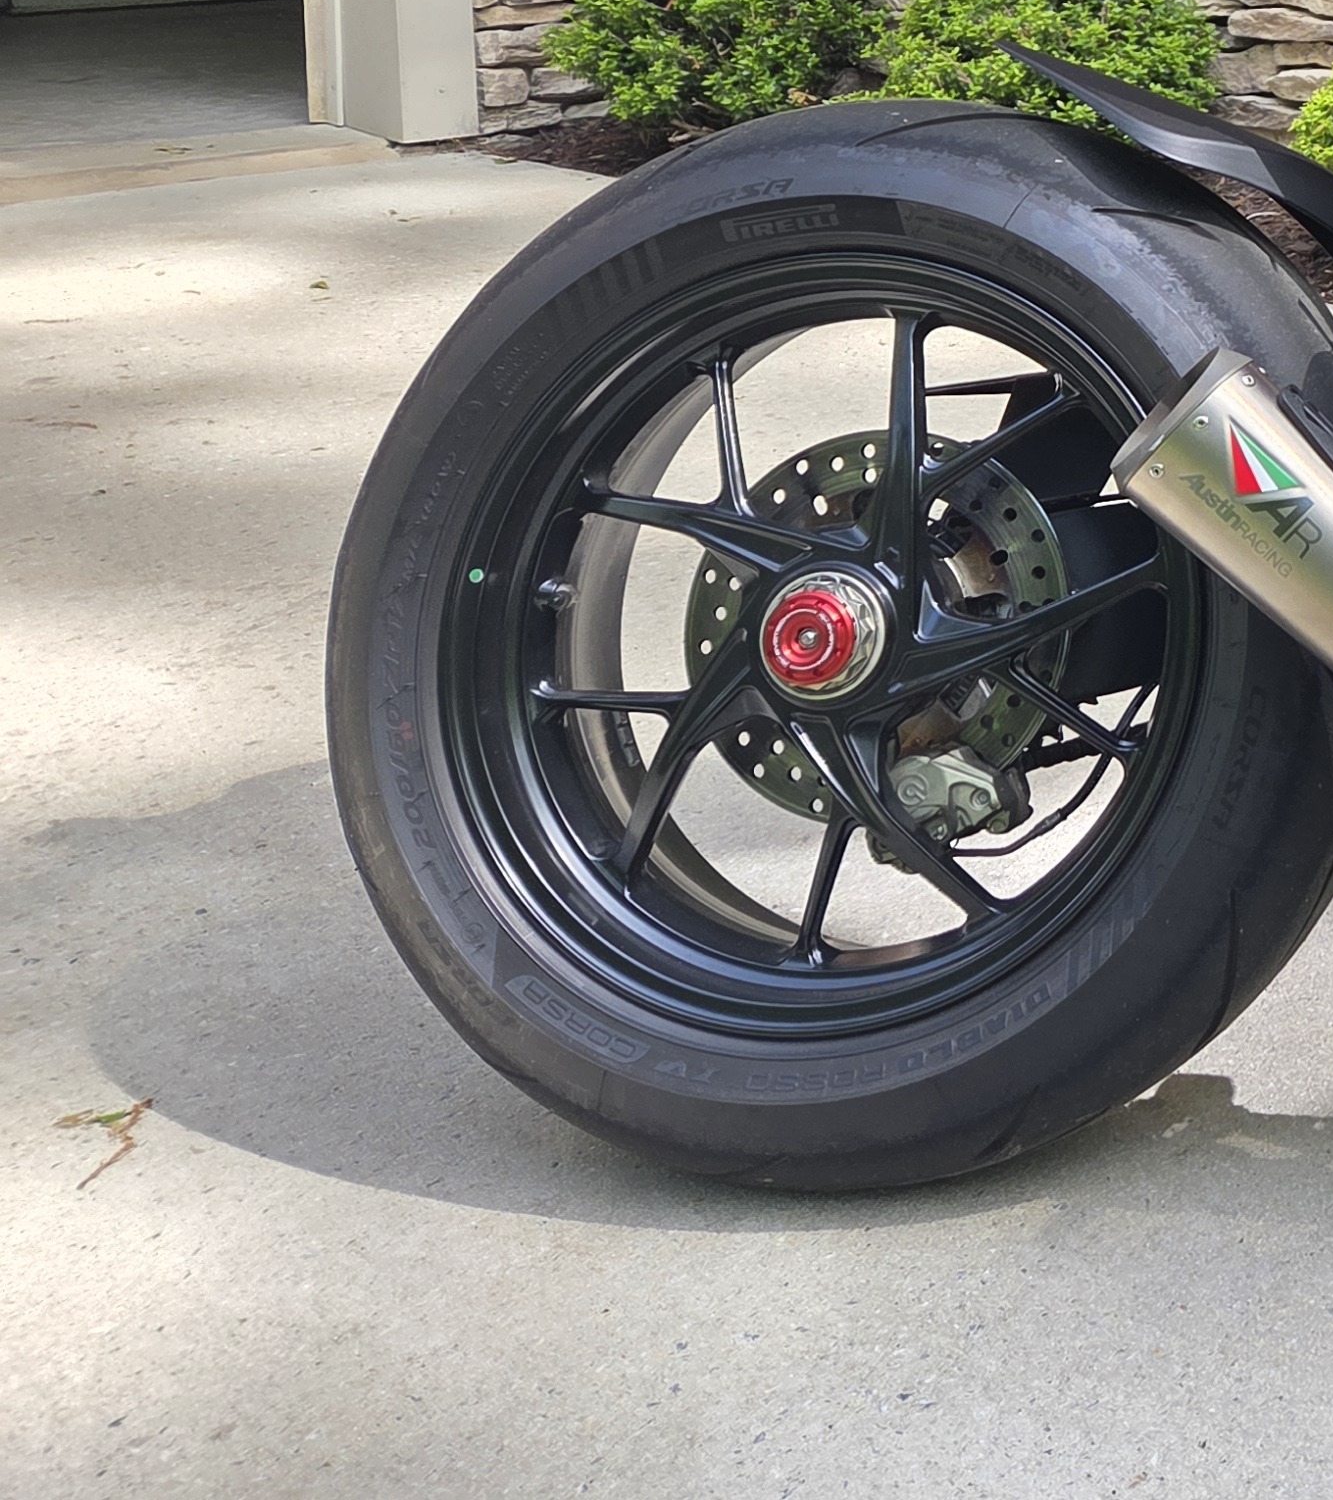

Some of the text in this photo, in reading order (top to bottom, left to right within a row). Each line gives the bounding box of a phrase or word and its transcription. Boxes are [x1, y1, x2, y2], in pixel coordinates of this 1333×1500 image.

[719, 203, 840, 243] PIRELLI
[522, 979, 638, 1060] CORSA
[901, 981, 1052, 1073] DIABLO
